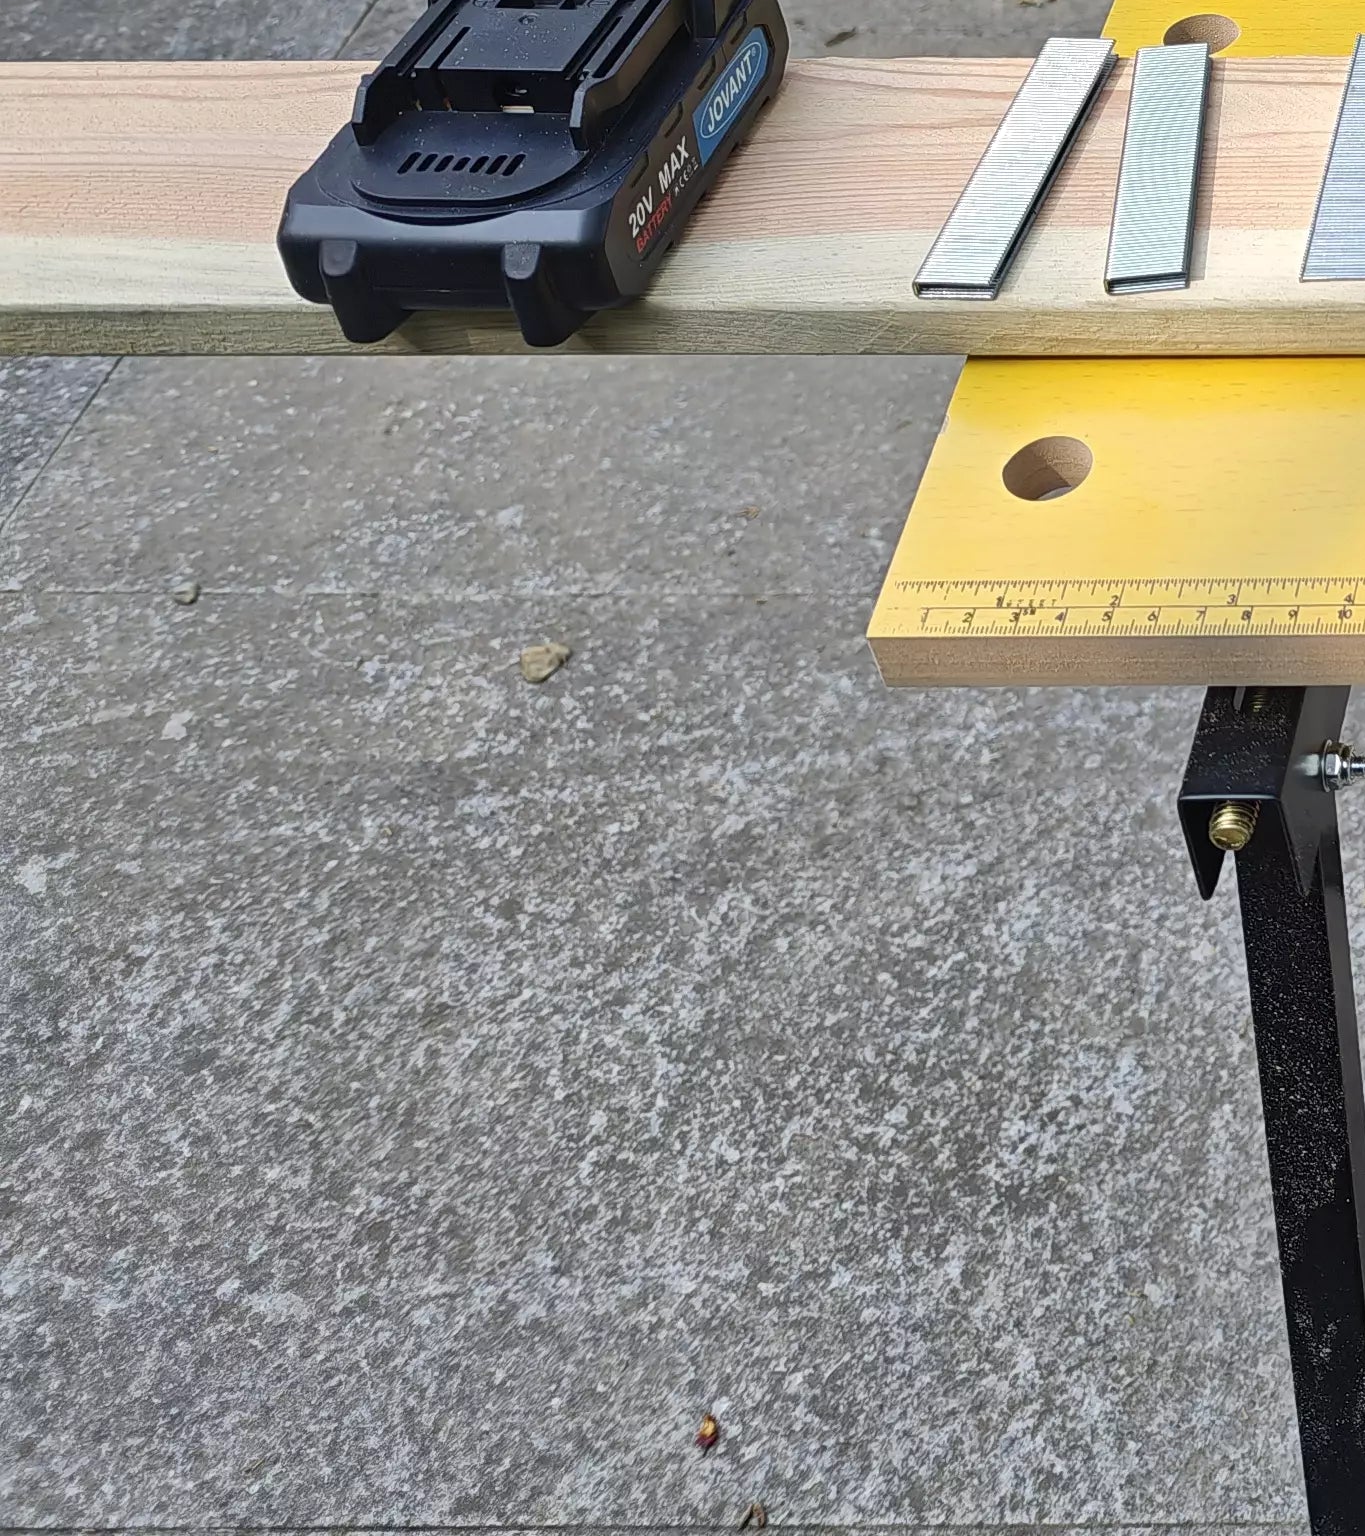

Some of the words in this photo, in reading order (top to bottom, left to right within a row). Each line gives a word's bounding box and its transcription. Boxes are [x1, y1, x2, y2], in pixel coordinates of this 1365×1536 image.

[708, 49, 753, 132] JOVANT
[628, 186, 654, 238] 20V
[658, 136, 690, 193] MAX
[637, 192, 672, 253] BATTERY
[1109, 595, 1119, 607] 2
[1226, 594, 1237, 605] 3
[1344, 593, 1354, 604] 4
